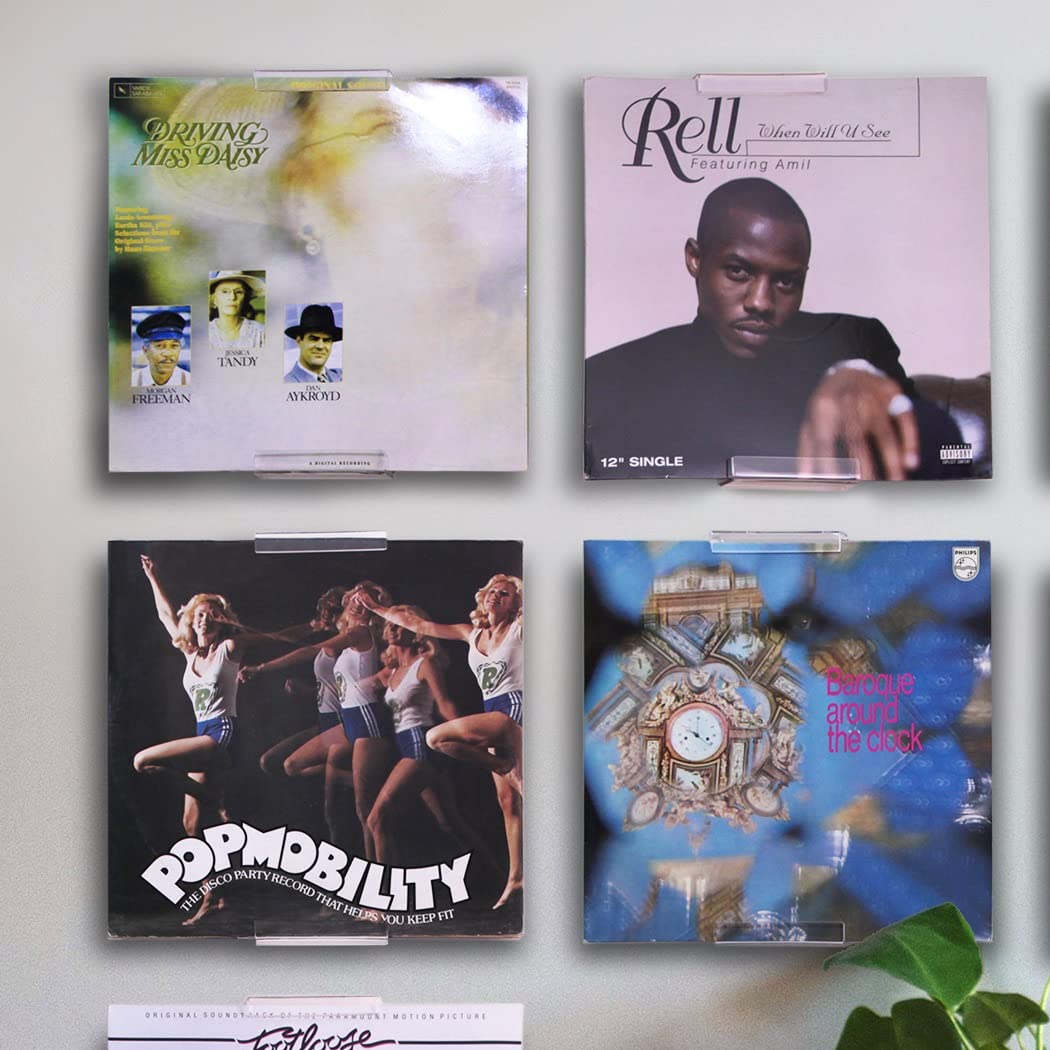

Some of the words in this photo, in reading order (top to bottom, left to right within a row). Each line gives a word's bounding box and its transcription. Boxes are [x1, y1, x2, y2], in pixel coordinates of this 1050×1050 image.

[143, 118, 269, 147] DRIVING
[621, 86, 742, 183] Rell
[757, 123, 800, 139] When
[804, 123, 837, 139] Will
[840, 123, 858, 139] U
[861, 123, 892, 139] See
[131, 143, 192, 169] MISS
[196, 143, 270, 171] DAISY
[690, 158, 768, 173] Featuring
[775, 158, 811, 171] Amil
[217, 356, 259, 367] TANDY
[132, 393, 192, 405] FREEMAN
[286, 391, 341, 402] AYKROYD
[600, 457, 624, 468] 12"
[629, 456, 684, 467] SINGLE
[826, 666, 915, 701] Baroque
[826, 694, 899, 725] around
[827, 720, 861, 753] the
[866, 721, 924, 754] clock
[141, 822, 472, 911] POPMOBILITY
[180, 891, 202, 912] THE
[199, 873, 233, 896] DISCO
[234, 870, 272, 881] PARTY
[271, 873, 316, 897] RECORD
[315, 891, 344, 912] THAT
[343, 904, 379, 922] HELPS
[381, 913, 405, 925] YOU
[407, 912, 437, 926] KEEP
[438, 908, 455, 920] FIT
